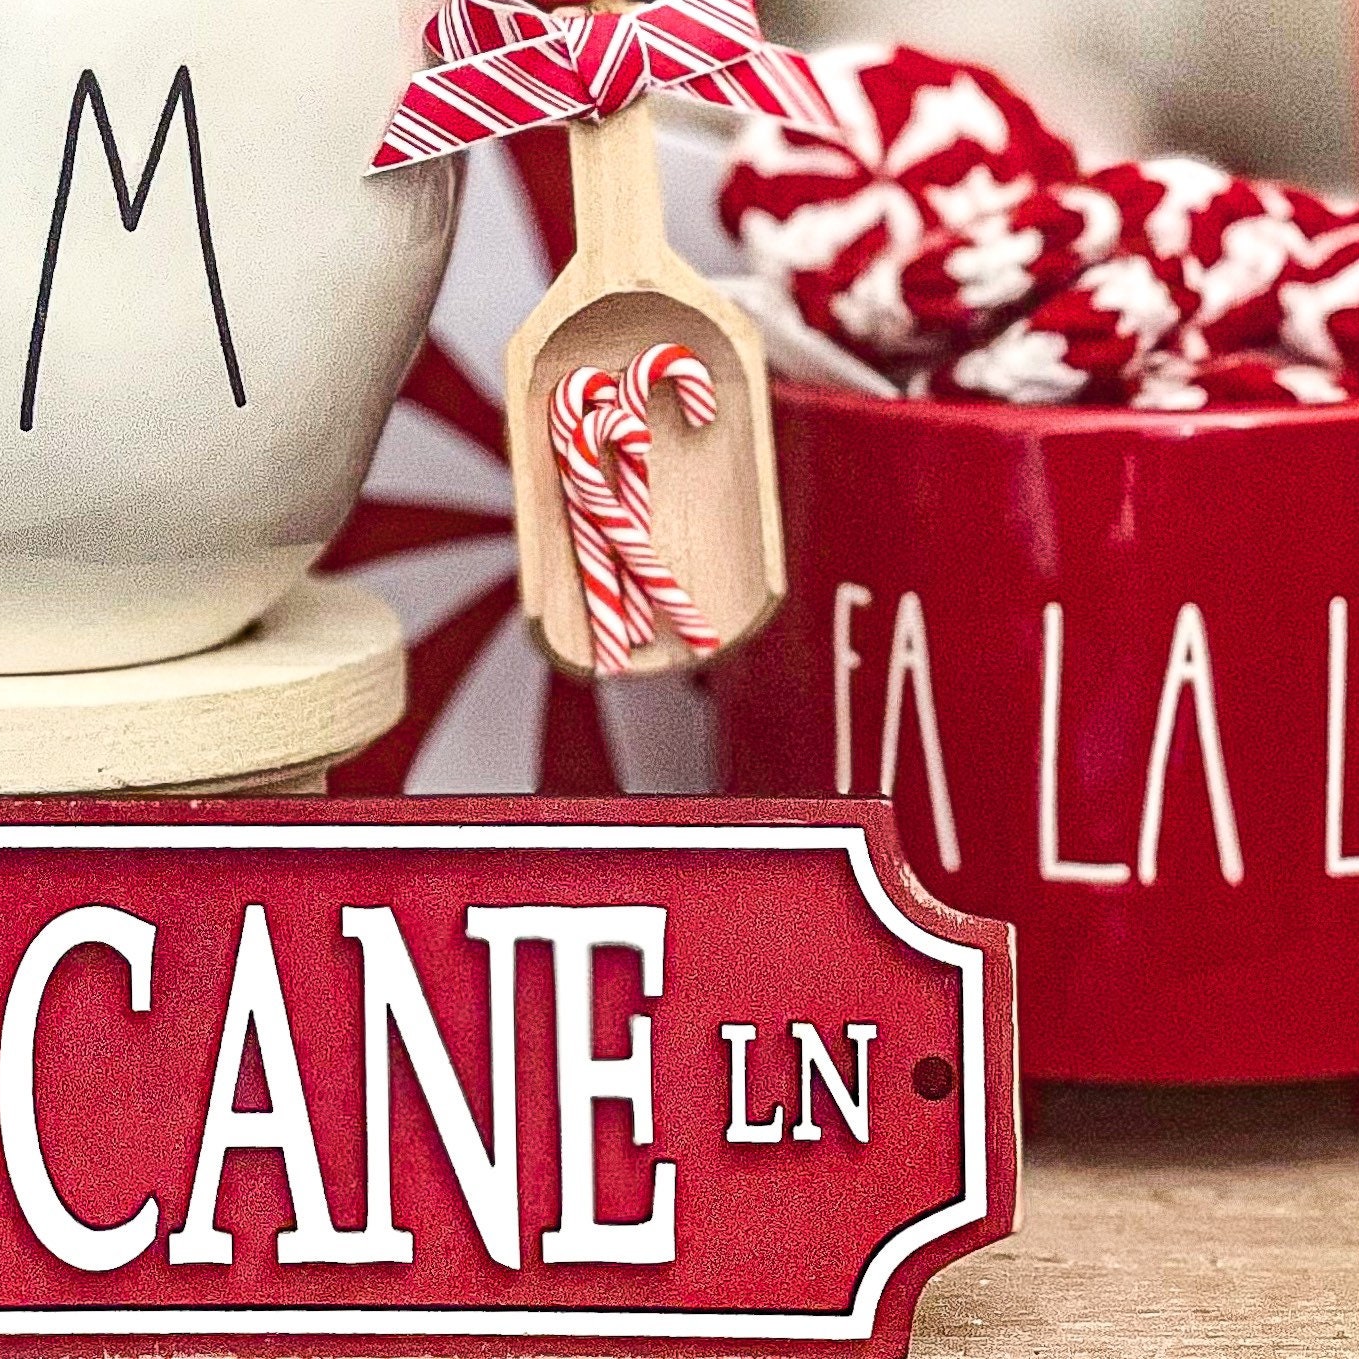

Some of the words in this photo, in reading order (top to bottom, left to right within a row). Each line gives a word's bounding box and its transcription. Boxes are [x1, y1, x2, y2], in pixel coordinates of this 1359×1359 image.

[834, 582, 961, 874] FA
[1040, 600, 1246, 886] LA
[720, 1023, 877, 1144] LN
